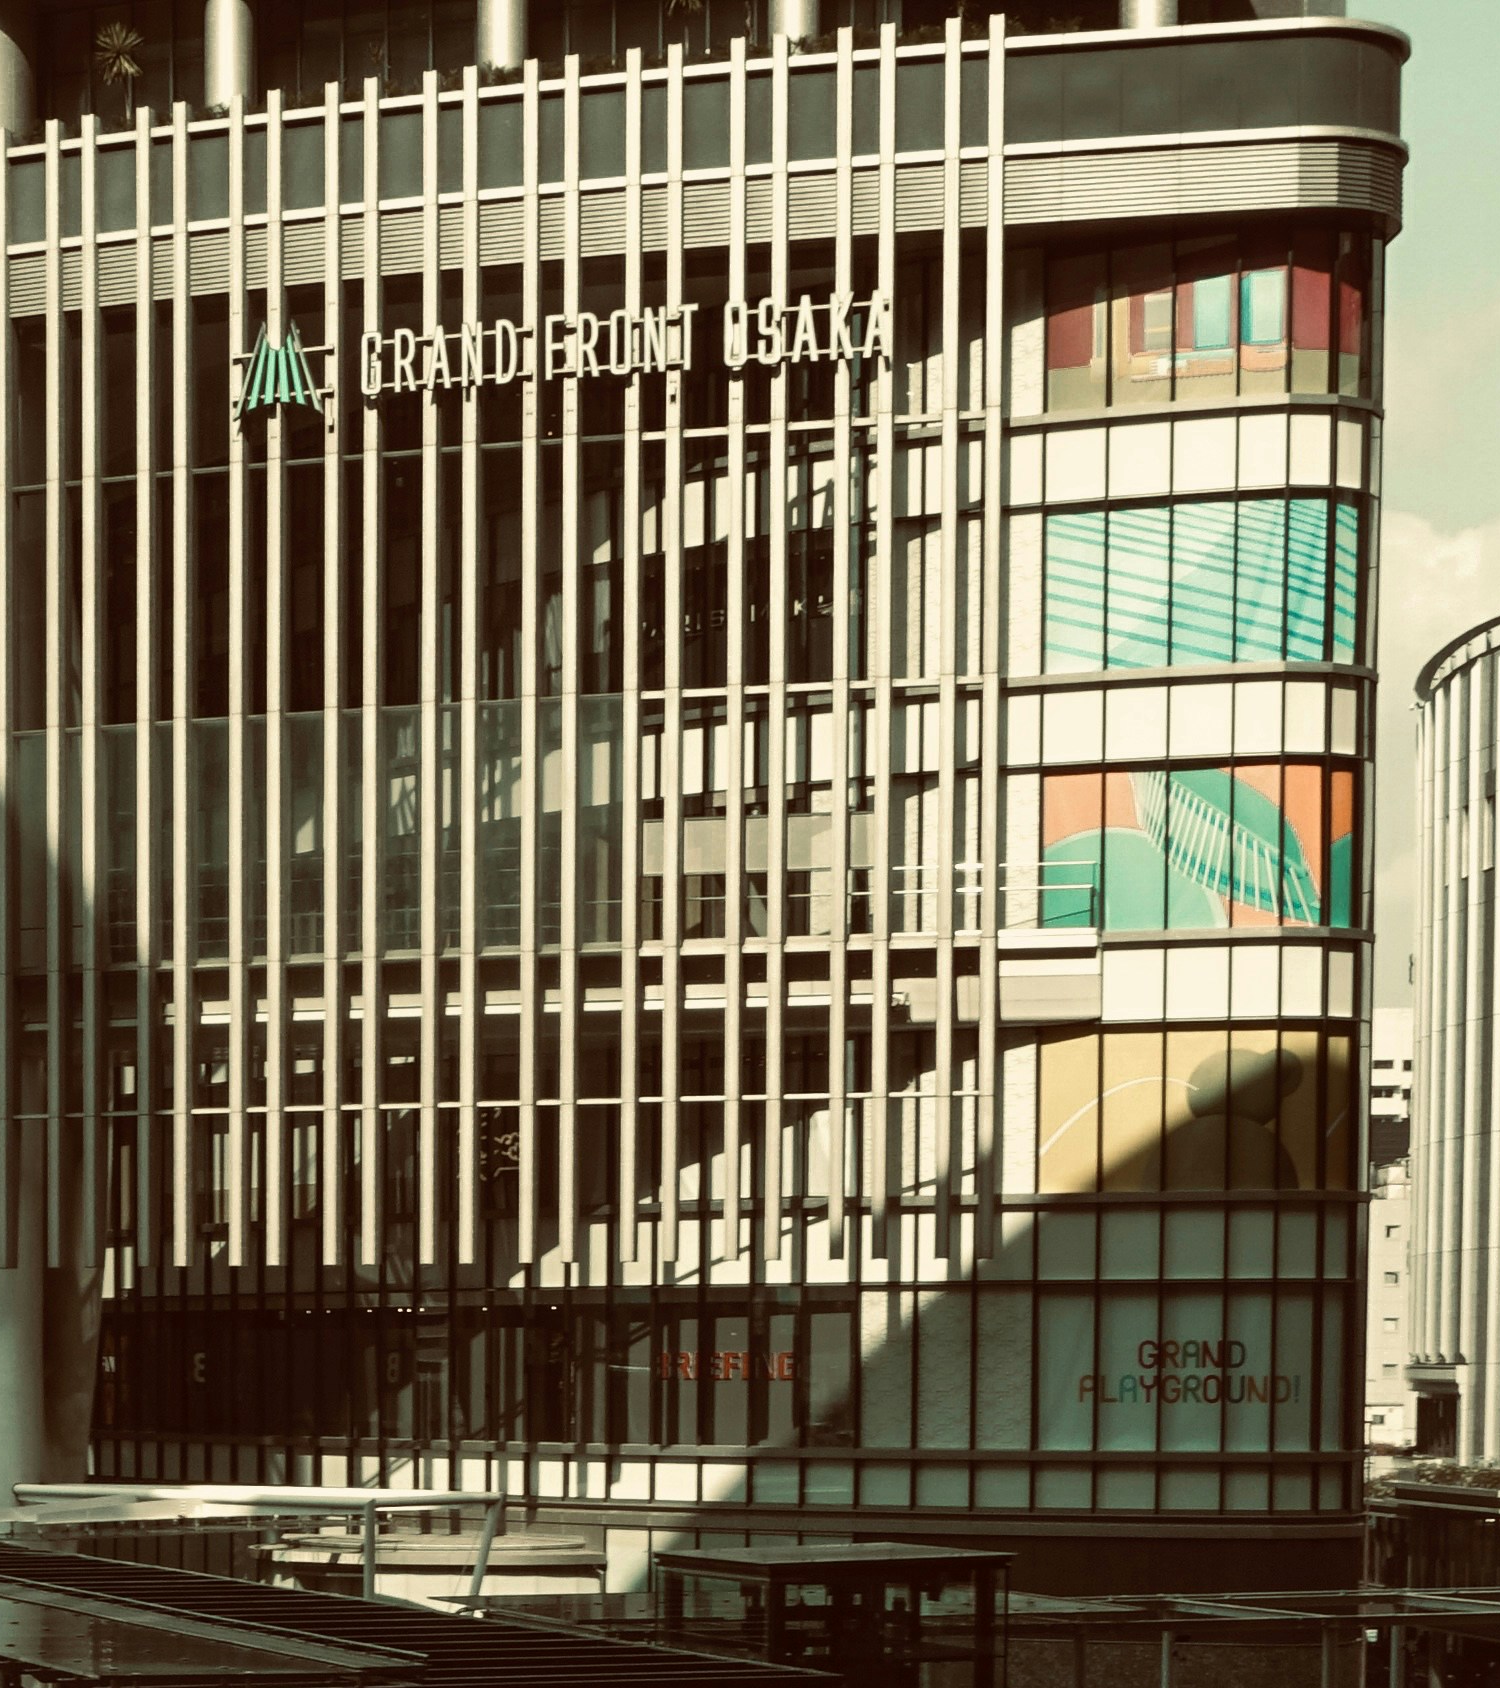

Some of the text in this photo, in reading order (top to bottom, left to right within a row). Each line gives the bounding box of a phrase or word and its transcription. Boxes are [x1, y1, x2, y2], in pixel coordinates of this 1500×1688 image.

[360, 288, 891, 396] GRAND FRONT OSAKA
[1138, 1340, 1246, 1368] GRAND
[1079, 1375, 1301, 1404] PLAYGROUND!
